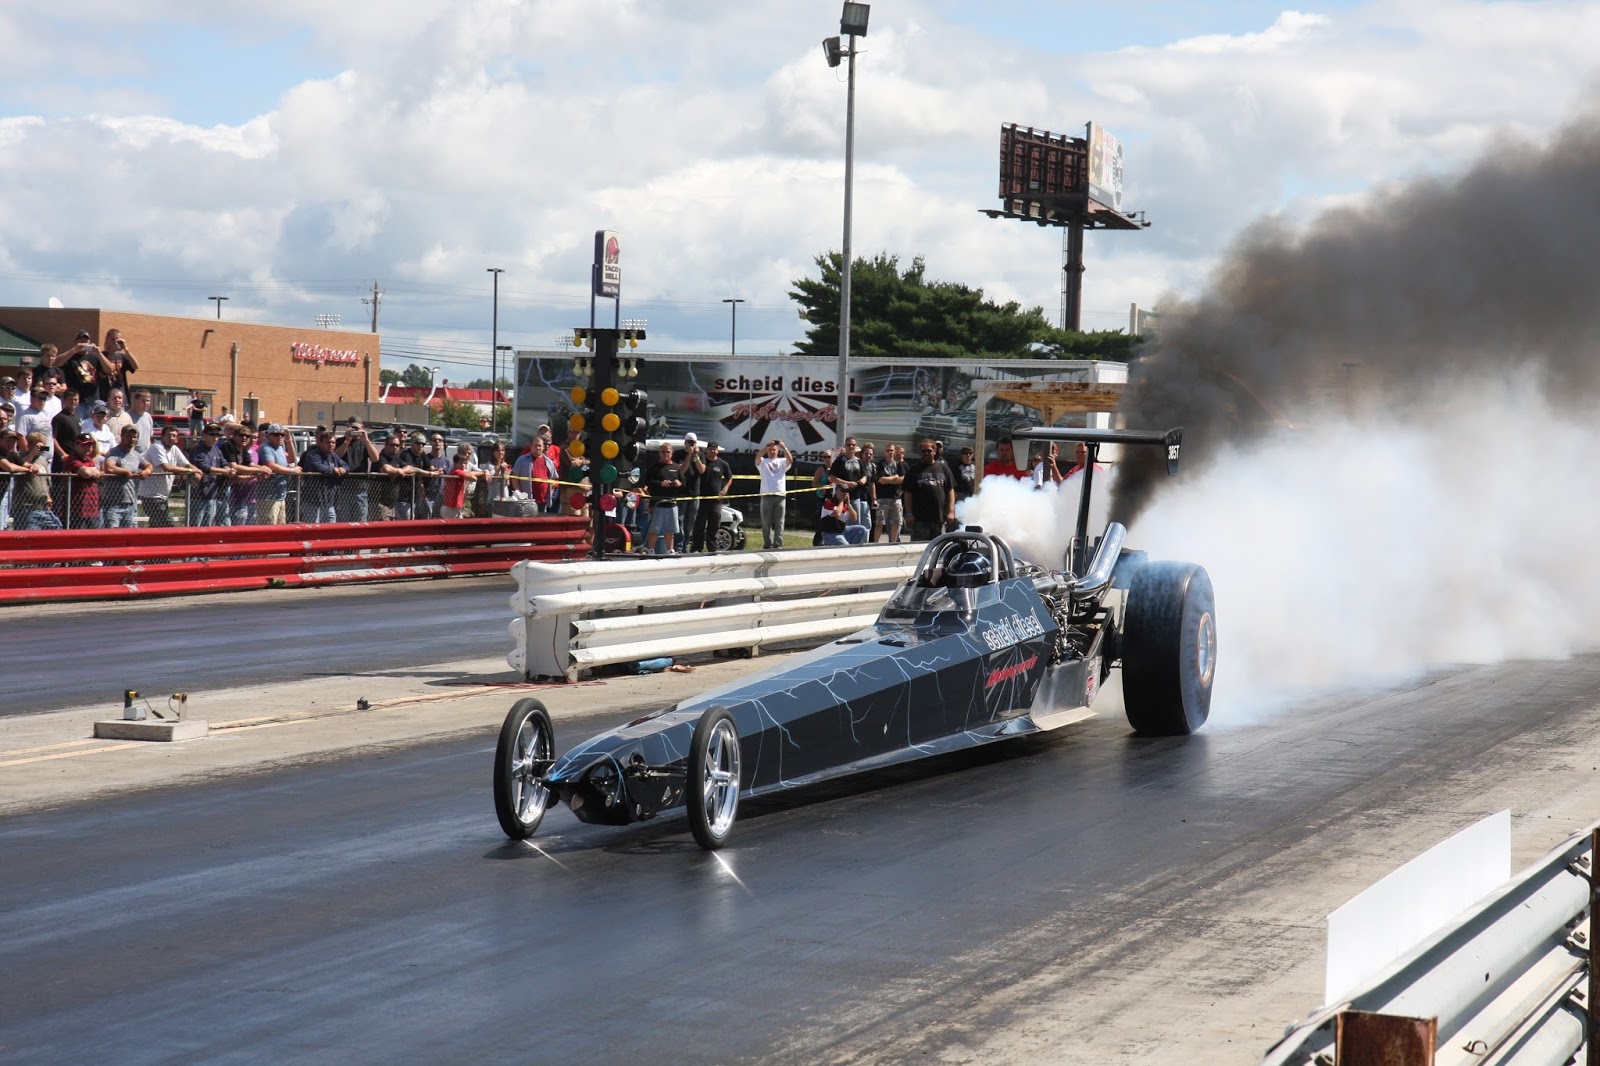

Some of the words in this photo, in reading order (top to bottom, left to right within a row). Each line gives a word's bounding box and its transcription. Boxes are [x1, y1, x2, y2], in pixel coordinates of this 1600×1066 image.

[605, 265, 618, 273] TACO
[292, 342, 360, 365] Walgreens
[714, 375, 783, 391] scheid
[791, 376, 855, 393] diesl
[982, 616, 1019, 651] scheid
[1011, 606, 1045, 641] diesel
